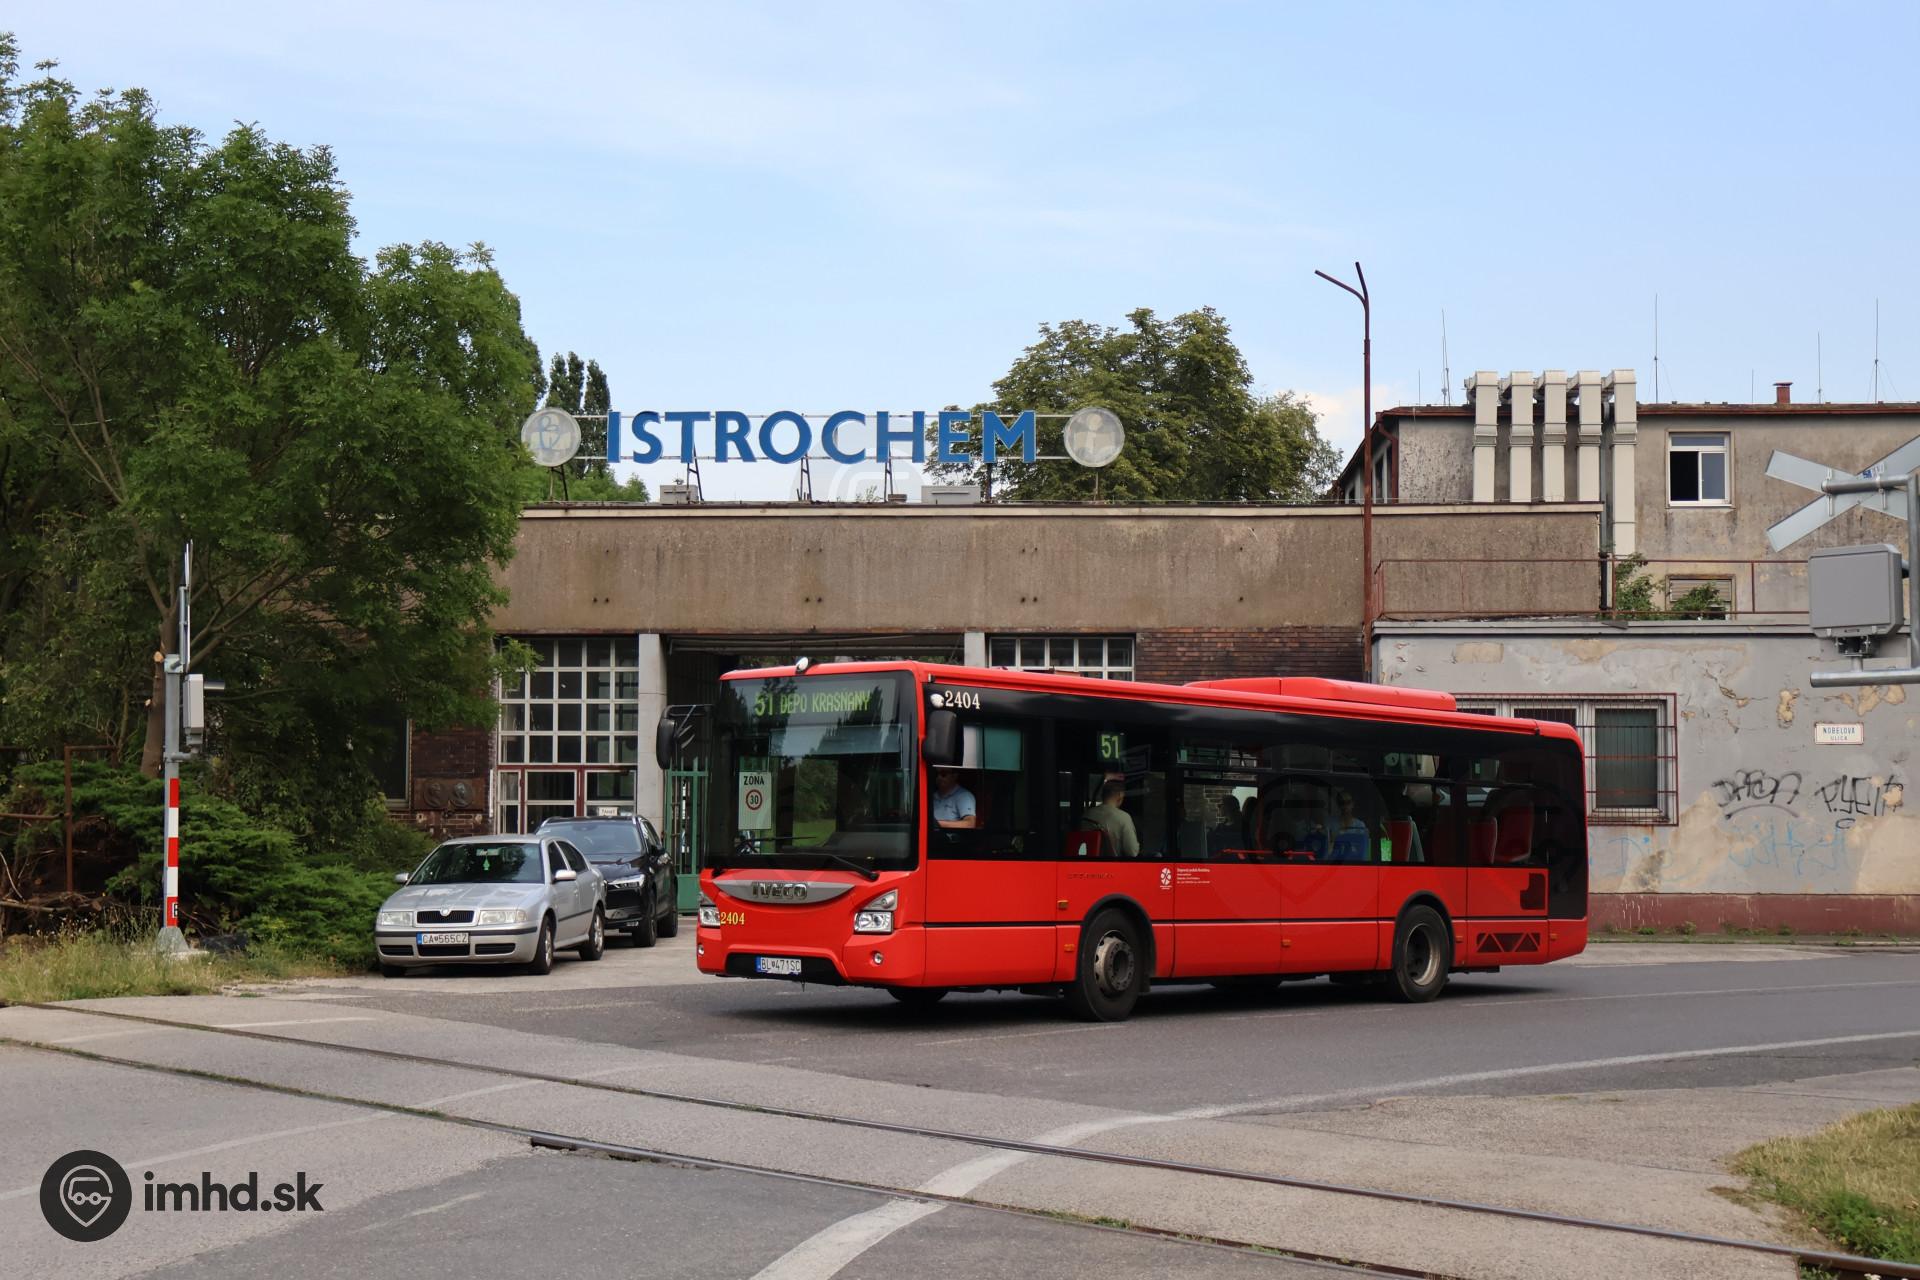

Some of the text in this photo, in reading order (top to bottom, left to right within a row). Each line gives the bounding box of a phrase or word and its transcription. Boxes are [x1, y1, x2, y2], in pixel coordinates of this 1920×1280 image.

[607, 410, 1037, 465] ISTROCHEM
[755, 692, 774, 716] 51
[780, 692, 808, 714] DEPO
[945, 690, 980, 710] 2404
[1823, 727, 1856, 735] NOBELOVA
[1101, 735, 1119, 759] 51
[743, 775, 765, 786] ZONA
[750, 794, 759, 805] 30
[751, 882, 808, 899] IVECO
[720, 911, 745, 926] 2404
